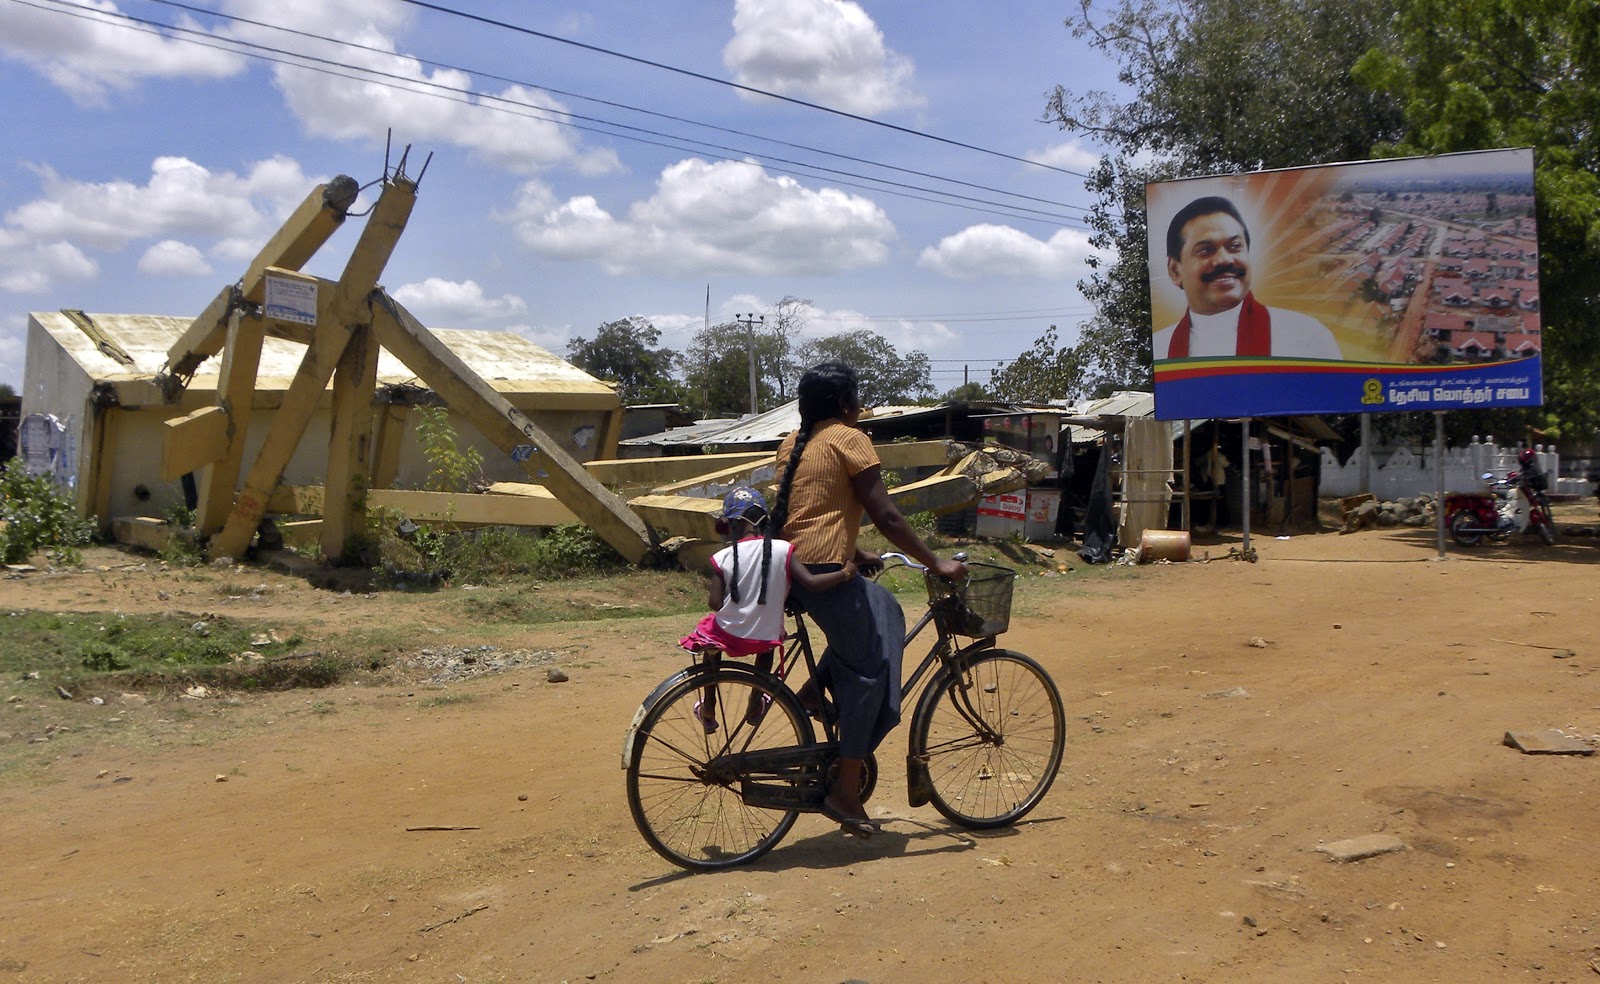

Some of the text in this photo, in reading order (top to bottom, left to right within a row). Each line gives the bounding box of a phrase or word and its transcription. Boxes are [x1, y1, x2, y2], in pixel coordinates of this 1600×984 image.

[1389, 387, 1529, 405] தேசிய லொத்தர் சபை
[1002, 503, 1021, 512] Dialog
